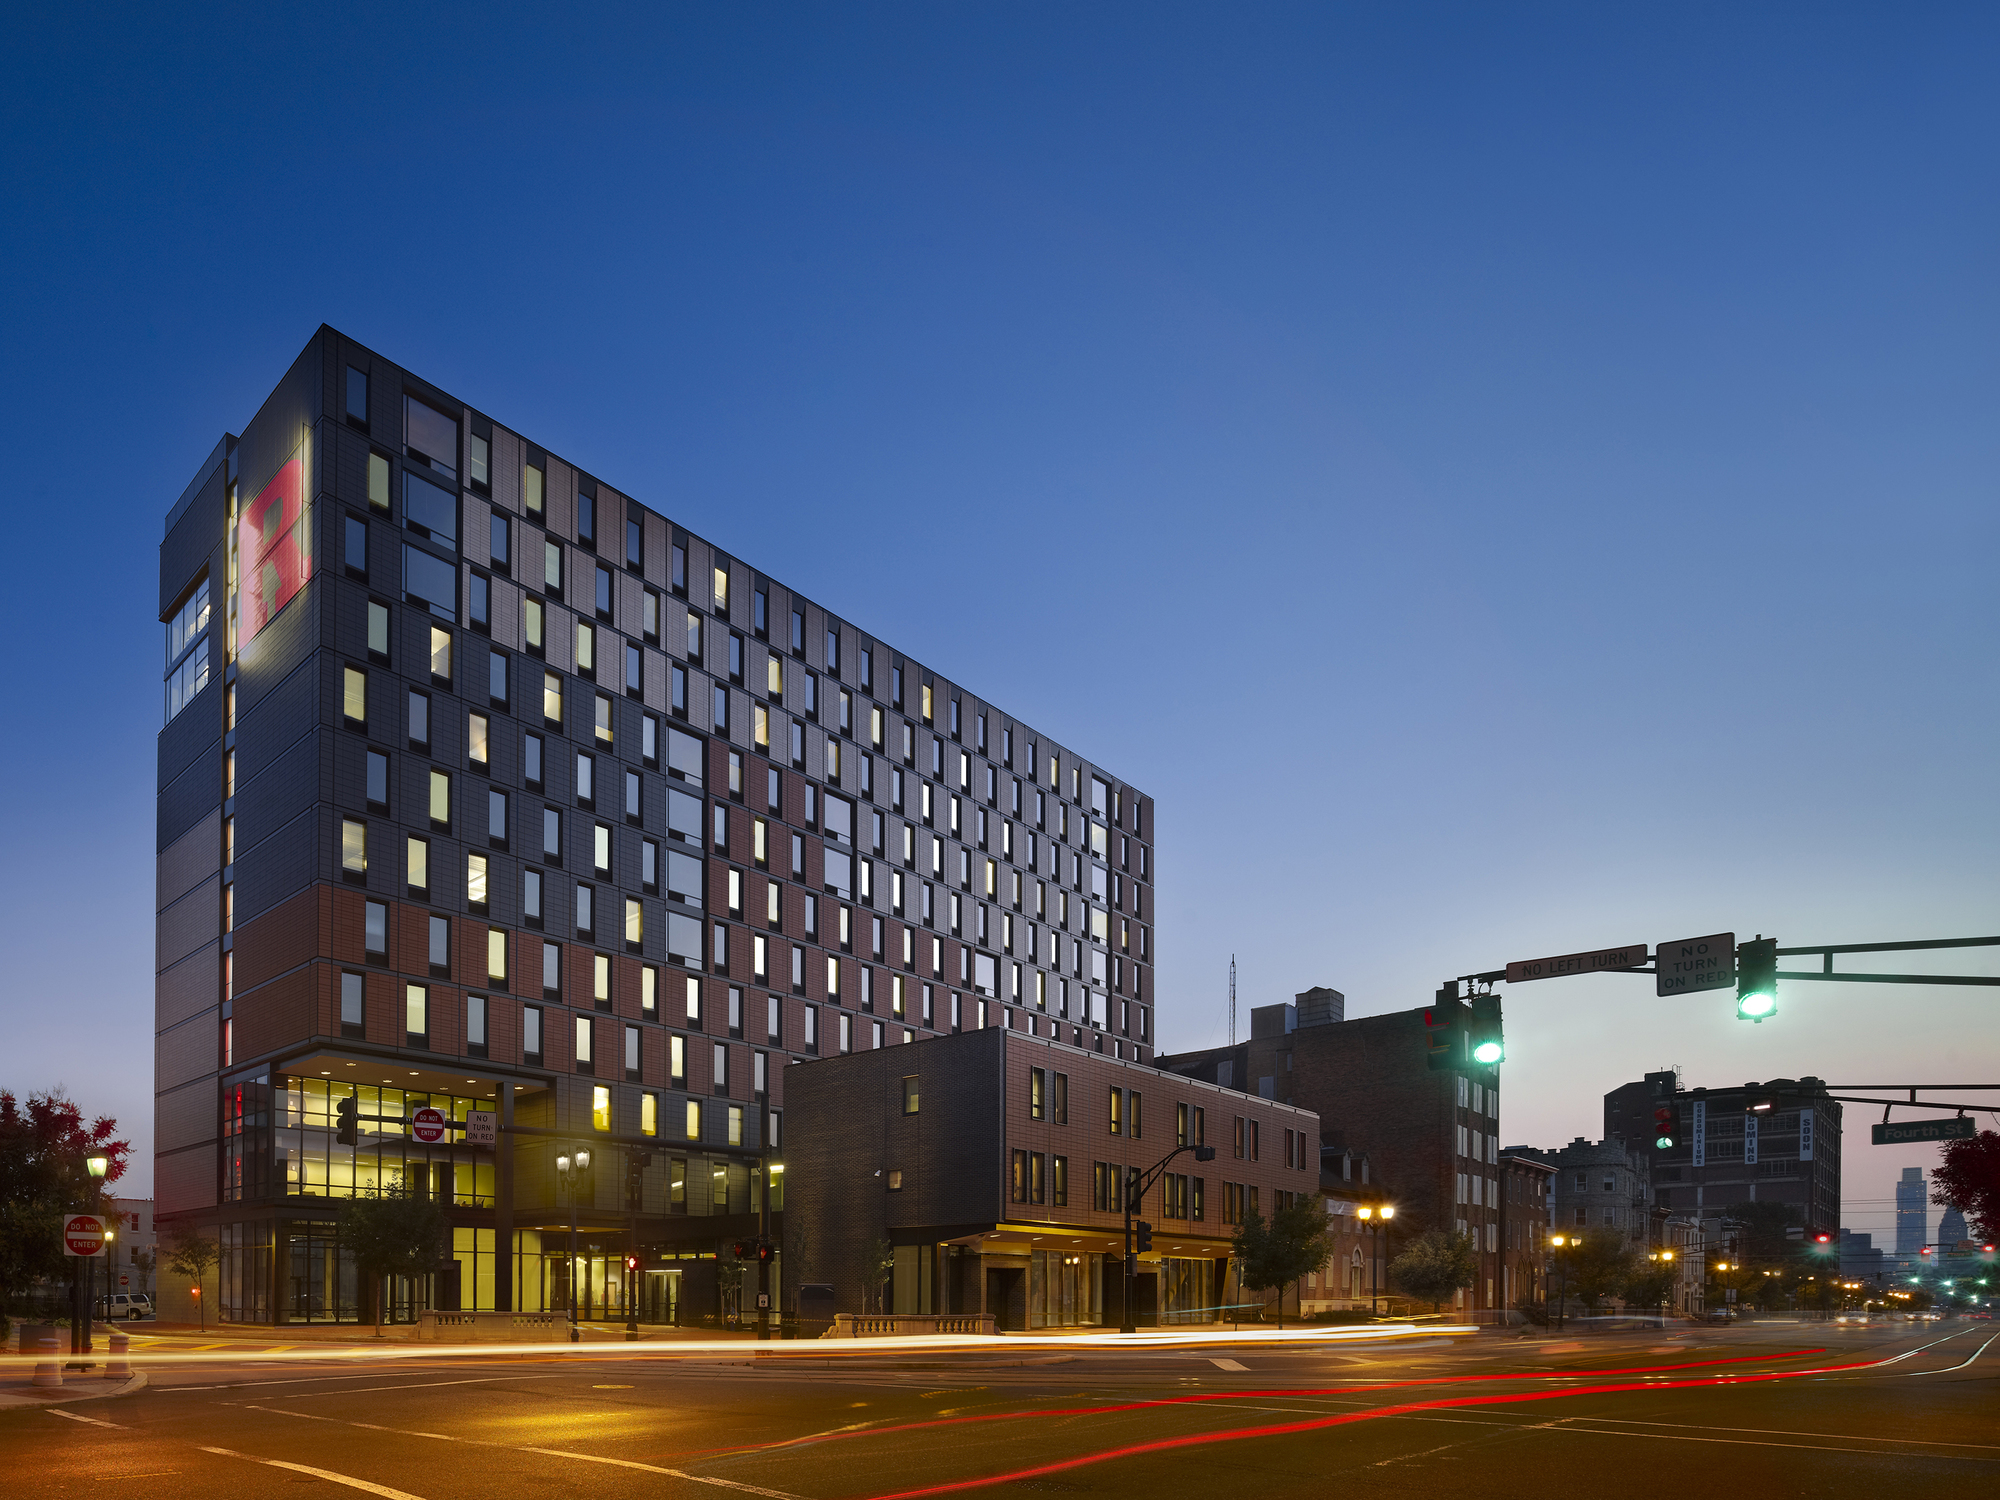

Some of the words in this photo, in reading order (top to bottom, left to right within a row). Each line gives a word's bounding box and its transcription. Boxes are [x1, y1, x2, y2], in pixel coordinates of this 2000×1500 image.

[238, 459, 311, 650] R
[1681, 943, 1709, 957] NO
[1522, 963, 1542, 977] NO
[1550, 957, 1584, 973] LEFT
[1590, 951, 1629, 968] TURN
[1673, 957, 1718, 973] TURN
[1664, 978, 1686, 989] ON
[1695, 970, 1728, 985] RED
[1746, 1115, 1756, 1162] COMING
[1802, 1119, 1810, 1150] SOON
[1885, 1126, 1939, 1139] Fourth
[1945, 1124, 1964, 1135] St
